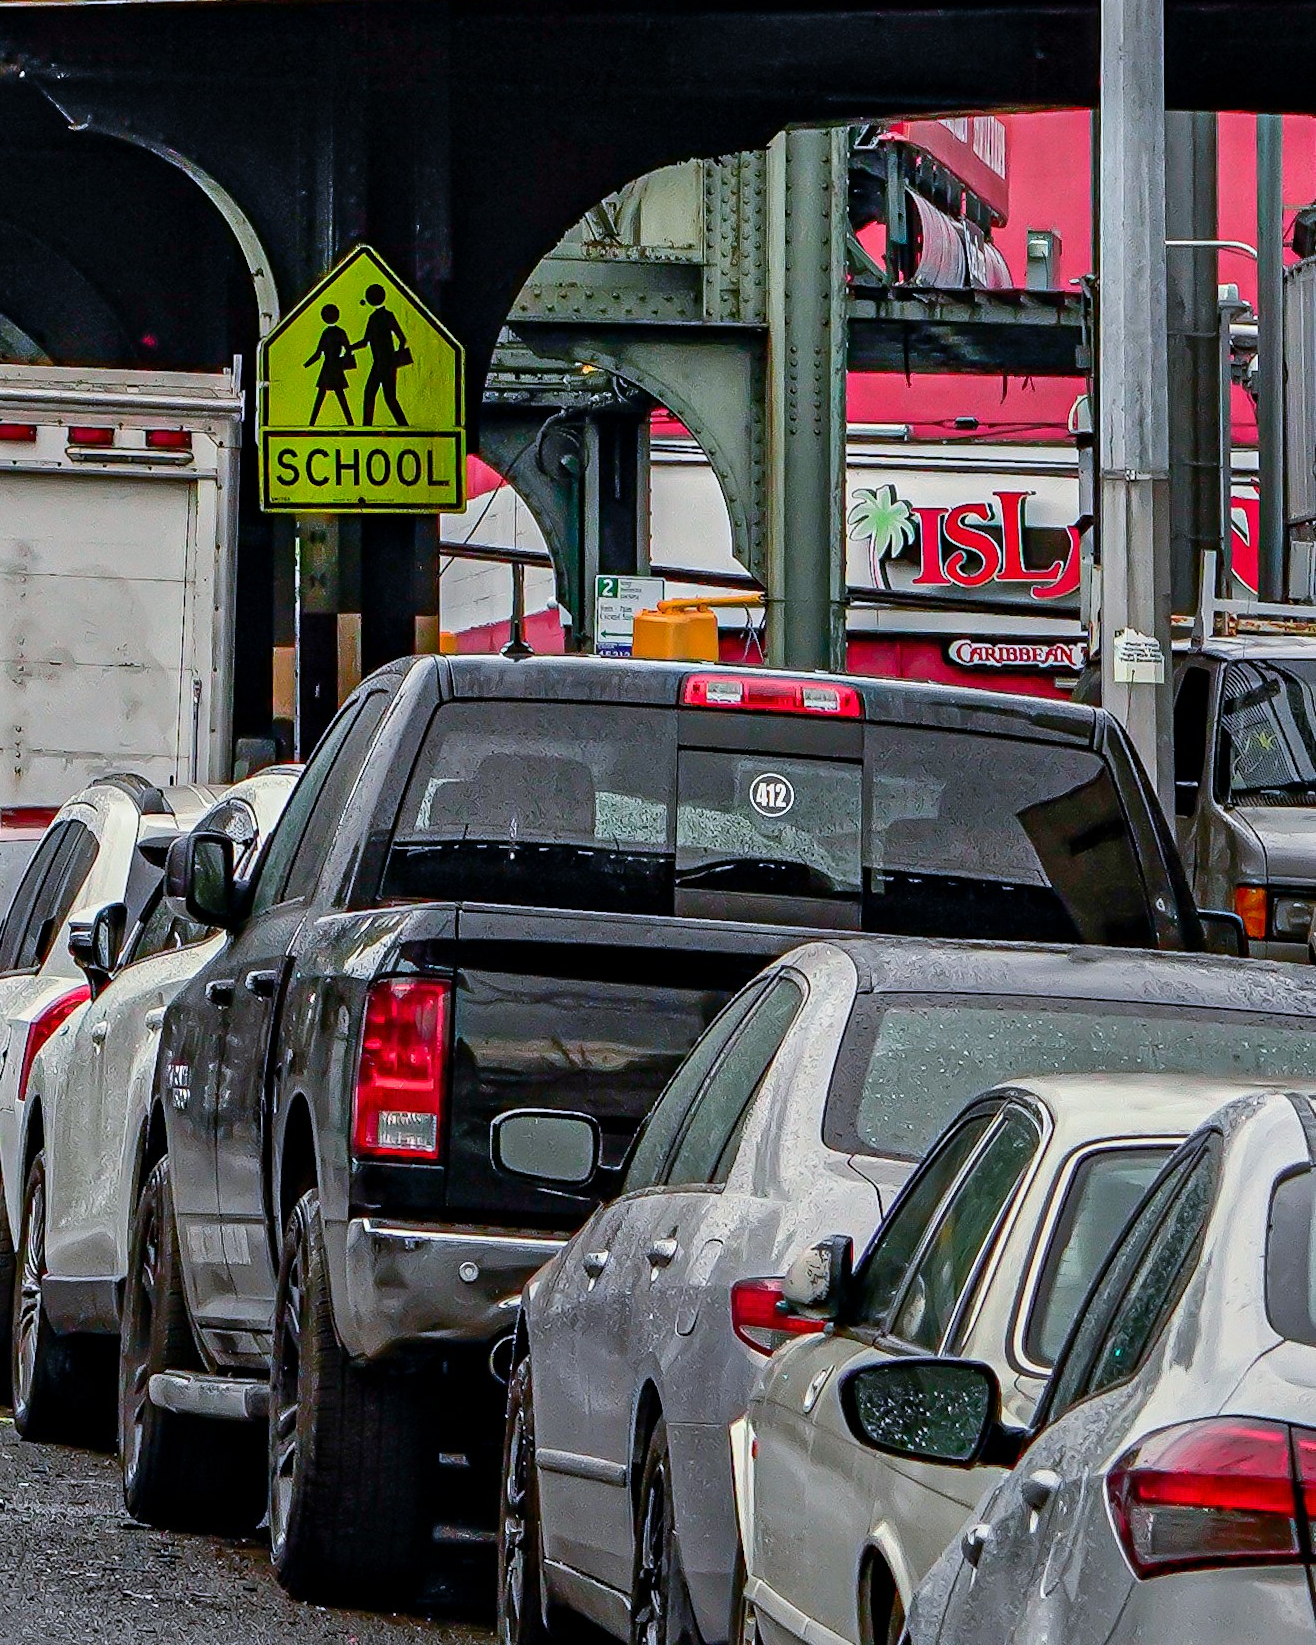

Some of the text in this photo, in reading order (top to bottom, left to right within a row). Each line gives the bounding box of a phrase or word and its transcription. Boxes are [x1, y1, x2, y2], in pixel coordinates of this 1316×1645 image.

[276, 448, 450, 487] SCHOOL
[602, 578, 614, 597] 2
[956, 641, 1078, 667] CARIBBEAN
[755, 782, 787, 808] 412
